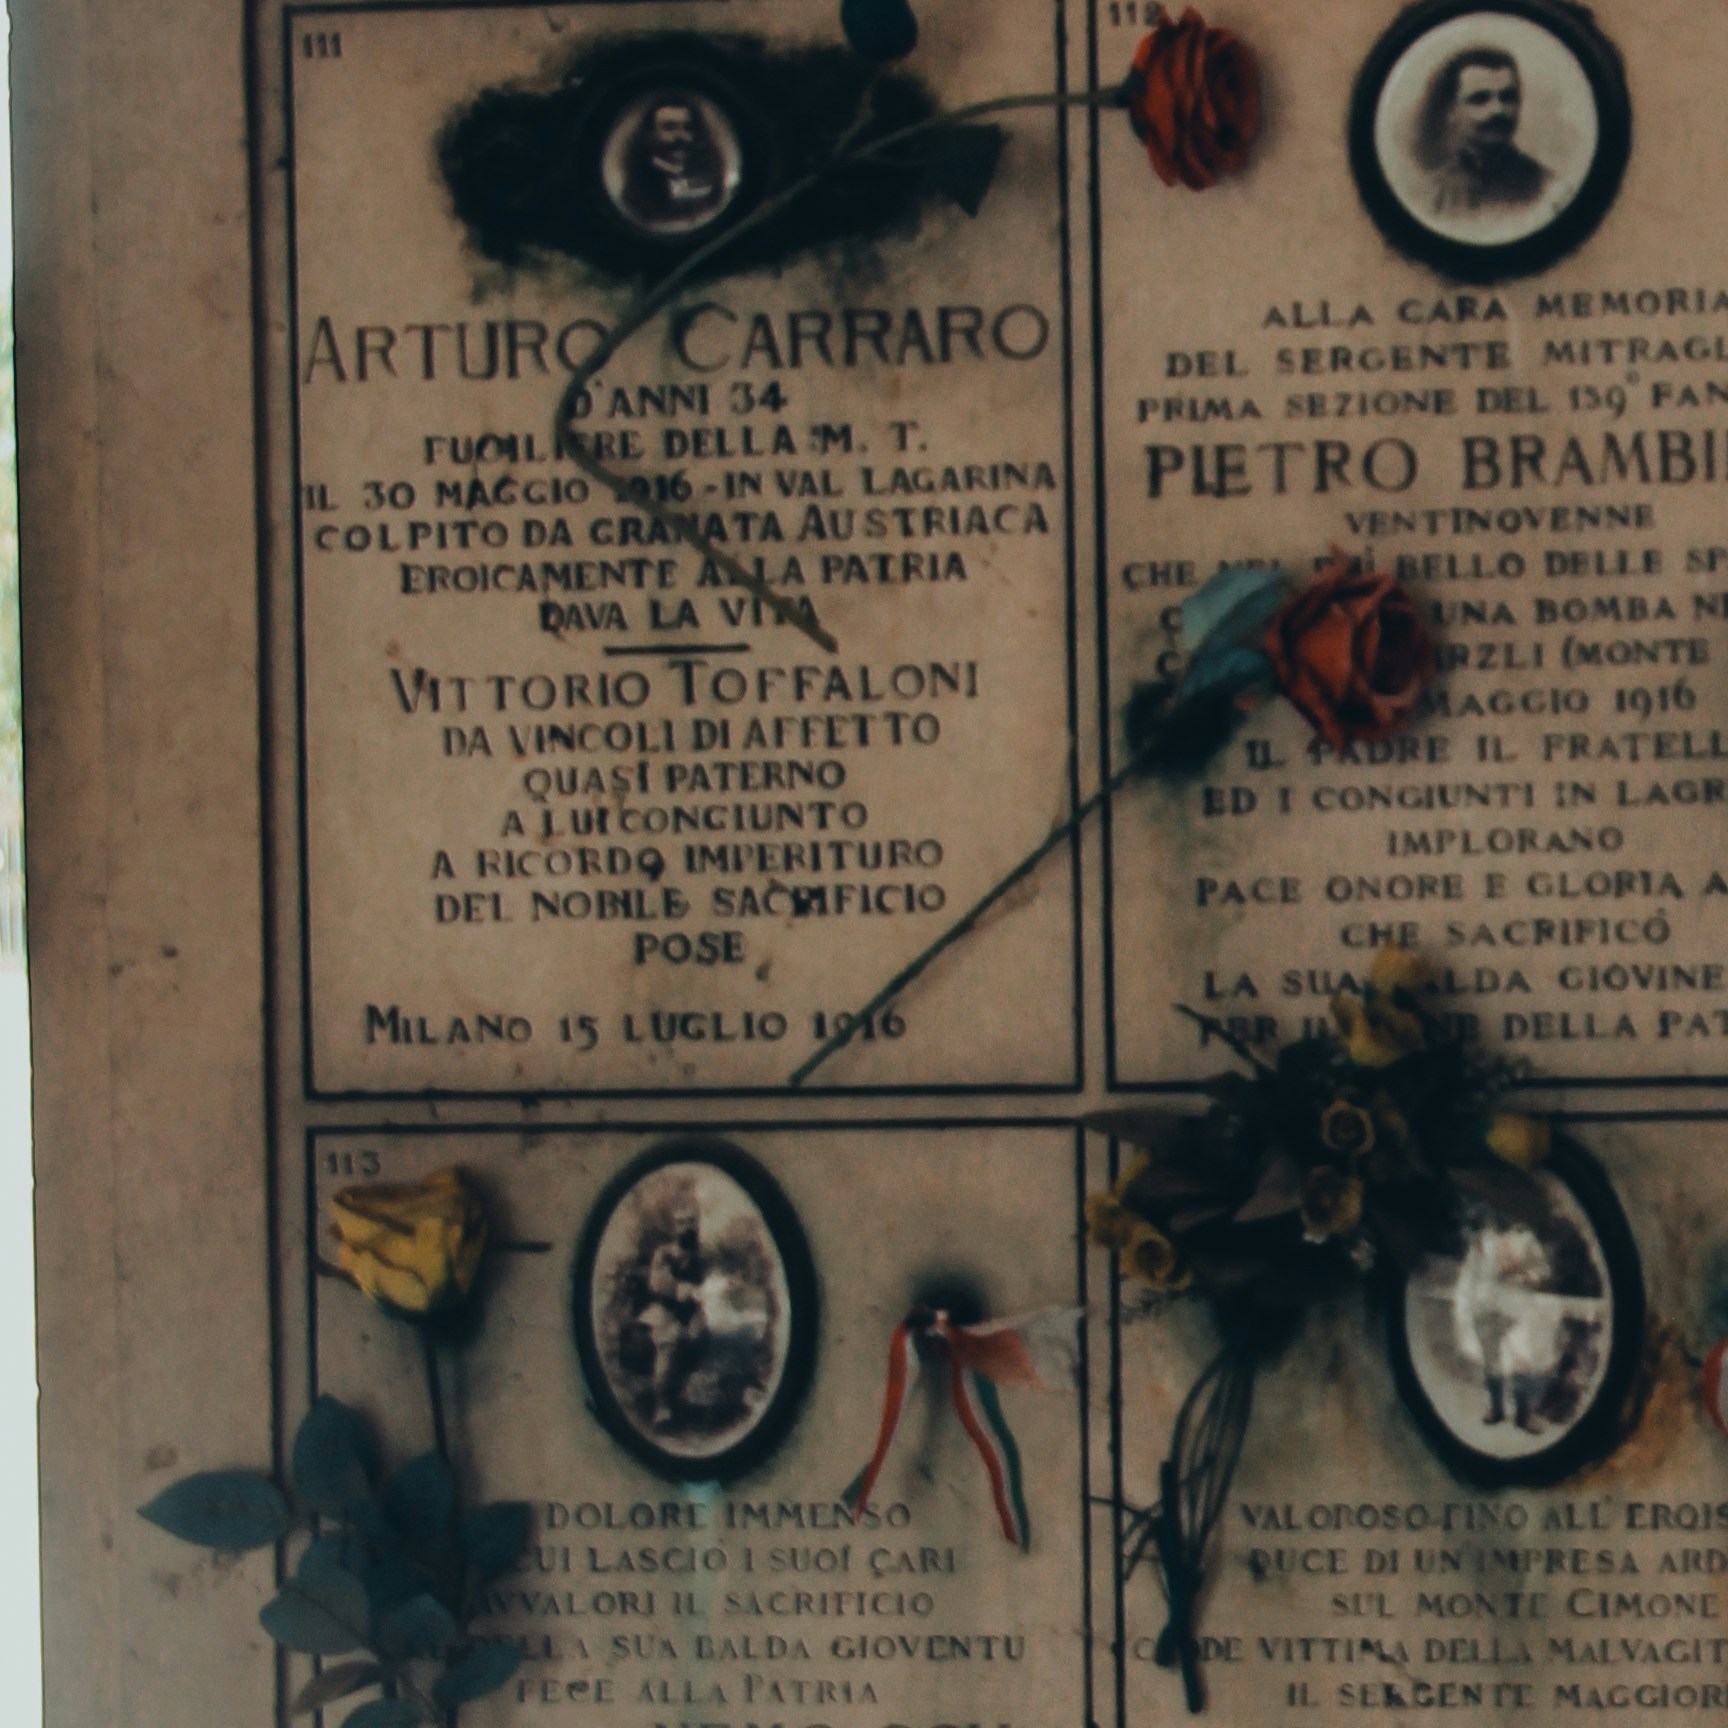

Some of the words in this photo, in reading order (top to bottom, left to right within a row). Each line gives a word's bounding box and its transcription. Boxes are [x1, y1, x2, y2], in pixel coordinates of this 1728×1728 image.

[1264, 300, 1373, 329] ALLA
[1398, 295, 1506, 323] CARA
[304, 313, 611, 385] ARTURO
[668, 303, 1049, 373] CARRARO
[1166, 351, 1249, 378] DEL
[1277, 340, 1510, 374] SERGENTE
[1145, 439, 1417, 499] PIETRO
[1345, 504, 1651, 537] VENTINOVENNE
[390, 667, 650, 714] VITTORIO
[680, 661, 977, 704] TOFFALONI
[443, 726, 492, 756] DA
[509, 720, 674, 757] VINCOLI
[693, 720, 729, 751] DI
[744, 712, 940, 749] AFFETTO
[523, 759, 649, 802] QUASI
[665, 761, 846, 793] PATERNO
[502, 810, 524, 837] A
[620, 799, 867, 834] CONGIUNTO
[1388, 827, 1623, 856] IMPLORANO
[432, 850, 455, 879] A
[477, 847, 665, 883] RICORDO
[685, 840, 943, 873] IMPERITURO
[436, 893, 512, 923] DEL
[532, 887, 689, 920] NOBILE
[1196, 878, 1297, 907] PACE
[1325, 874, 1462, 903] ONORE
[1486, 873, 1503, 899] E
[1527, 870, 1684, 899] GLORIA
[1703, 865, 1728, 895] A
[634, 932, 743, 966] POSE
[365, 1004, 531, 1045] MILANO
[560, 1015, 598, 1051] 15
[623, 1010, 787, 1043] LUGLIO
[1332, 1593, 1392, 1618] SUL
[1419, 1591, 1545, 1619] MONTE
[1566, 1588, 1718, 1619] CIMONE
[1287, 1684, 1317, 1706] IL
[1340, 1680, 1534, 1709] SERGENTE
